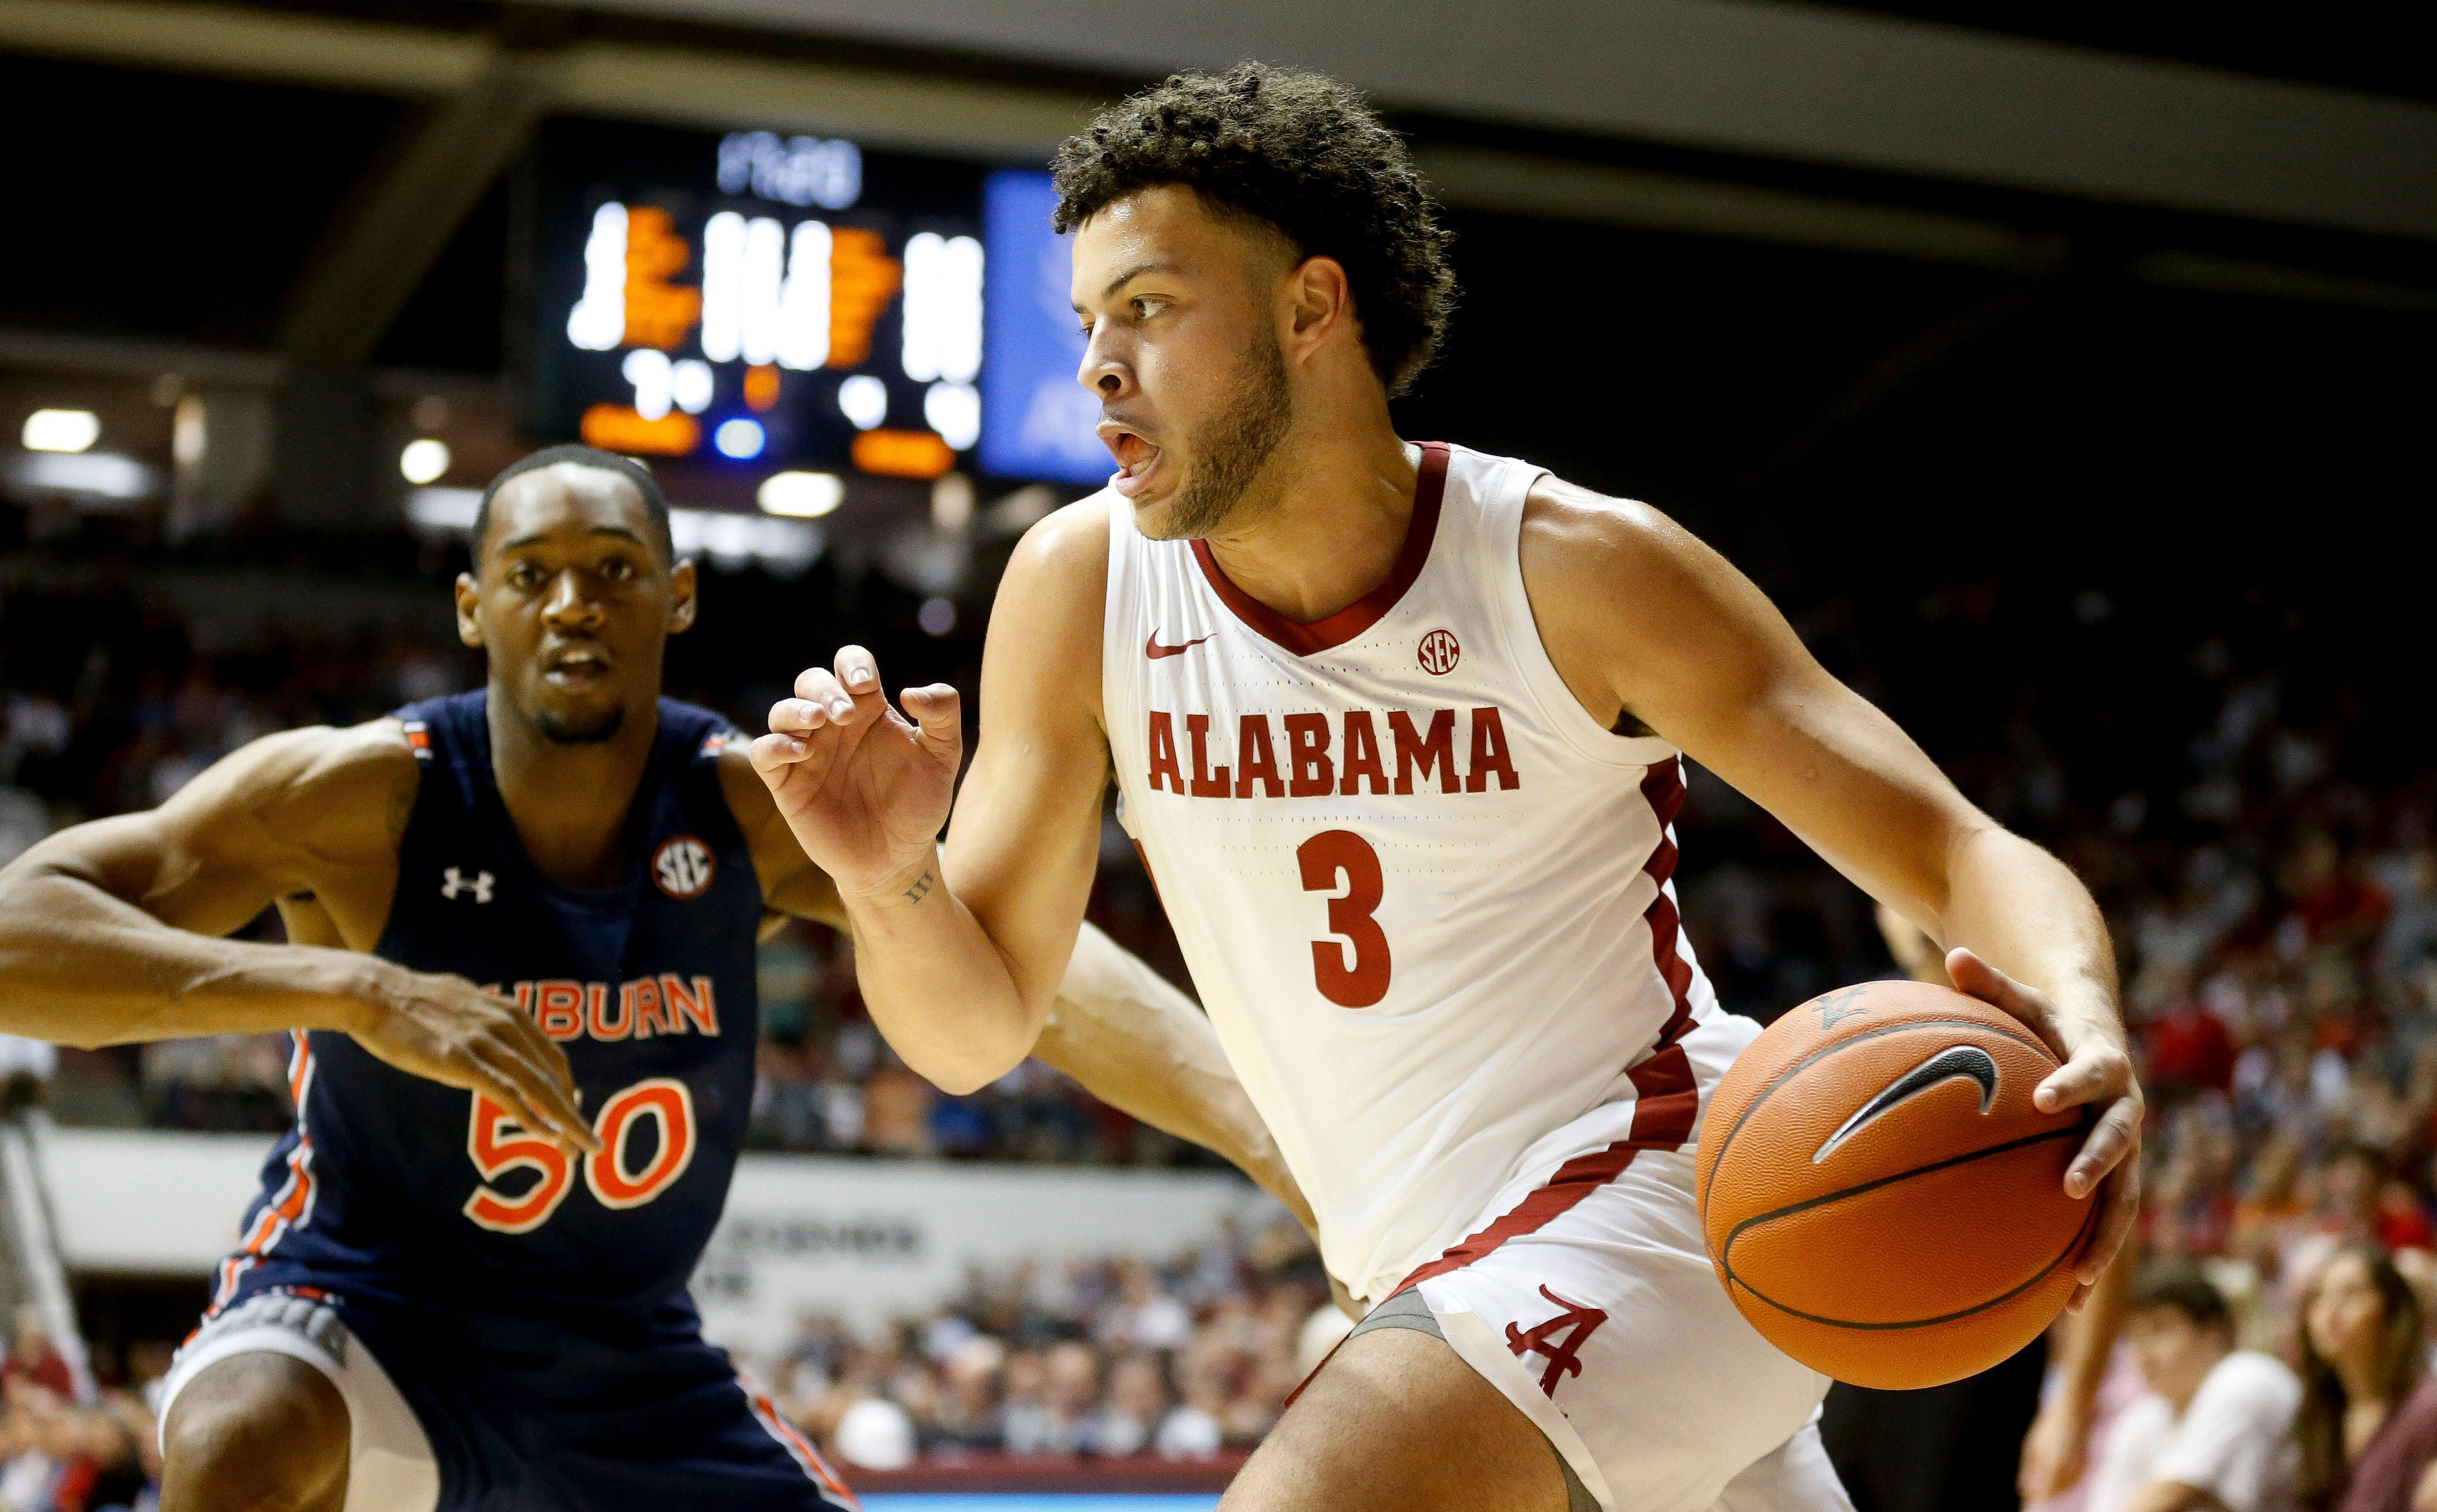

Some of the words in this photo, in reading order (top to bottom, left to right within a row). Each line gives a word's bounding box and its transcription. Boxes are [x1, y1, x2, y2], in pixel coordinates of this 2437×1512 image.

[1420, 632, 1458, 673] SEC
[1147, 706, 1520, 799] ALABAMA
[656, 839, 711, 895] SEC
[1296, 830, 1391, 1009] 3
[485, 972, 721, 1043] BURN
[463, 1077, 697, 1234] 50
